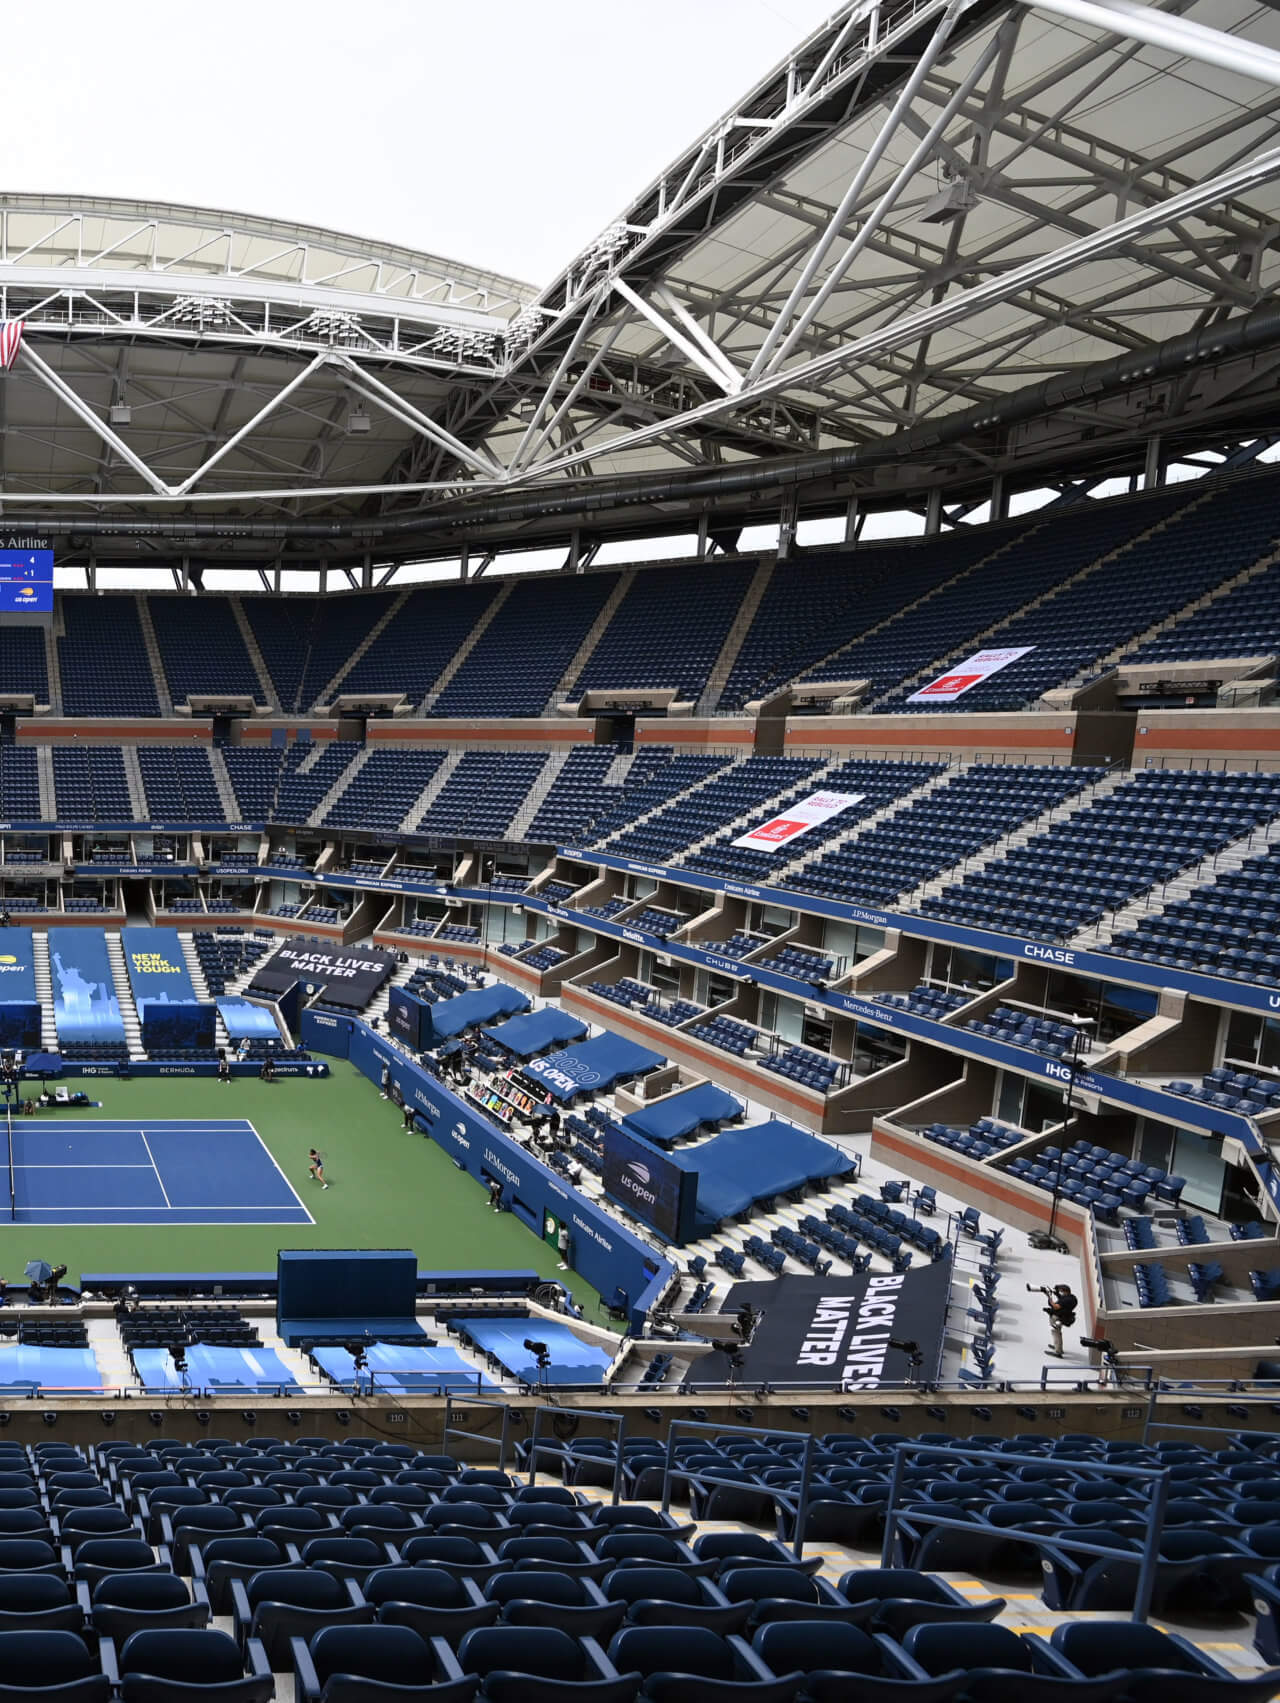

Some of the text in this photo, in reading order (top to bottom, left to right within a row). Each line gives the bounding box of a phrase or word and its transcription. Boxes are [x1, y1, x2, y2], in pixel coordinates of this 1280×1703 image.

[7, 537, 48, 549] Airline
[29, 556, 35, 564] 4
[851, 909, 887, 924] J.P.Morgan
[279, 950, 385, 973] BLACK LIVES
[705, 957, 738, 972] CHUBB
[1024, 944, 1075, 965] CHASE
[290, 960, 357, 978] MATTER
[842, 999, 893, 1022] Mercedes-Benz
[529, 1058, 579, 1092] US OPEN
[542, 1051, 600, 1084] 2020
[1045, 1062, 1072, 1080] IHG
[414, 1089, 441, 1118] J.P.Morgan
[483, 1148, 520, 1186] J.P.Morgan
[621, 1173, 655, 1205] us open
[572, 1214, 612, 1252] Emirates Airline
[797, 1296, 855, 1366] MATTER
[842, 1275, 905, 1393] BLACK LIVES
[391, 1414, 404, 1422] 110
[452, 1413, 463, 1422] 111
